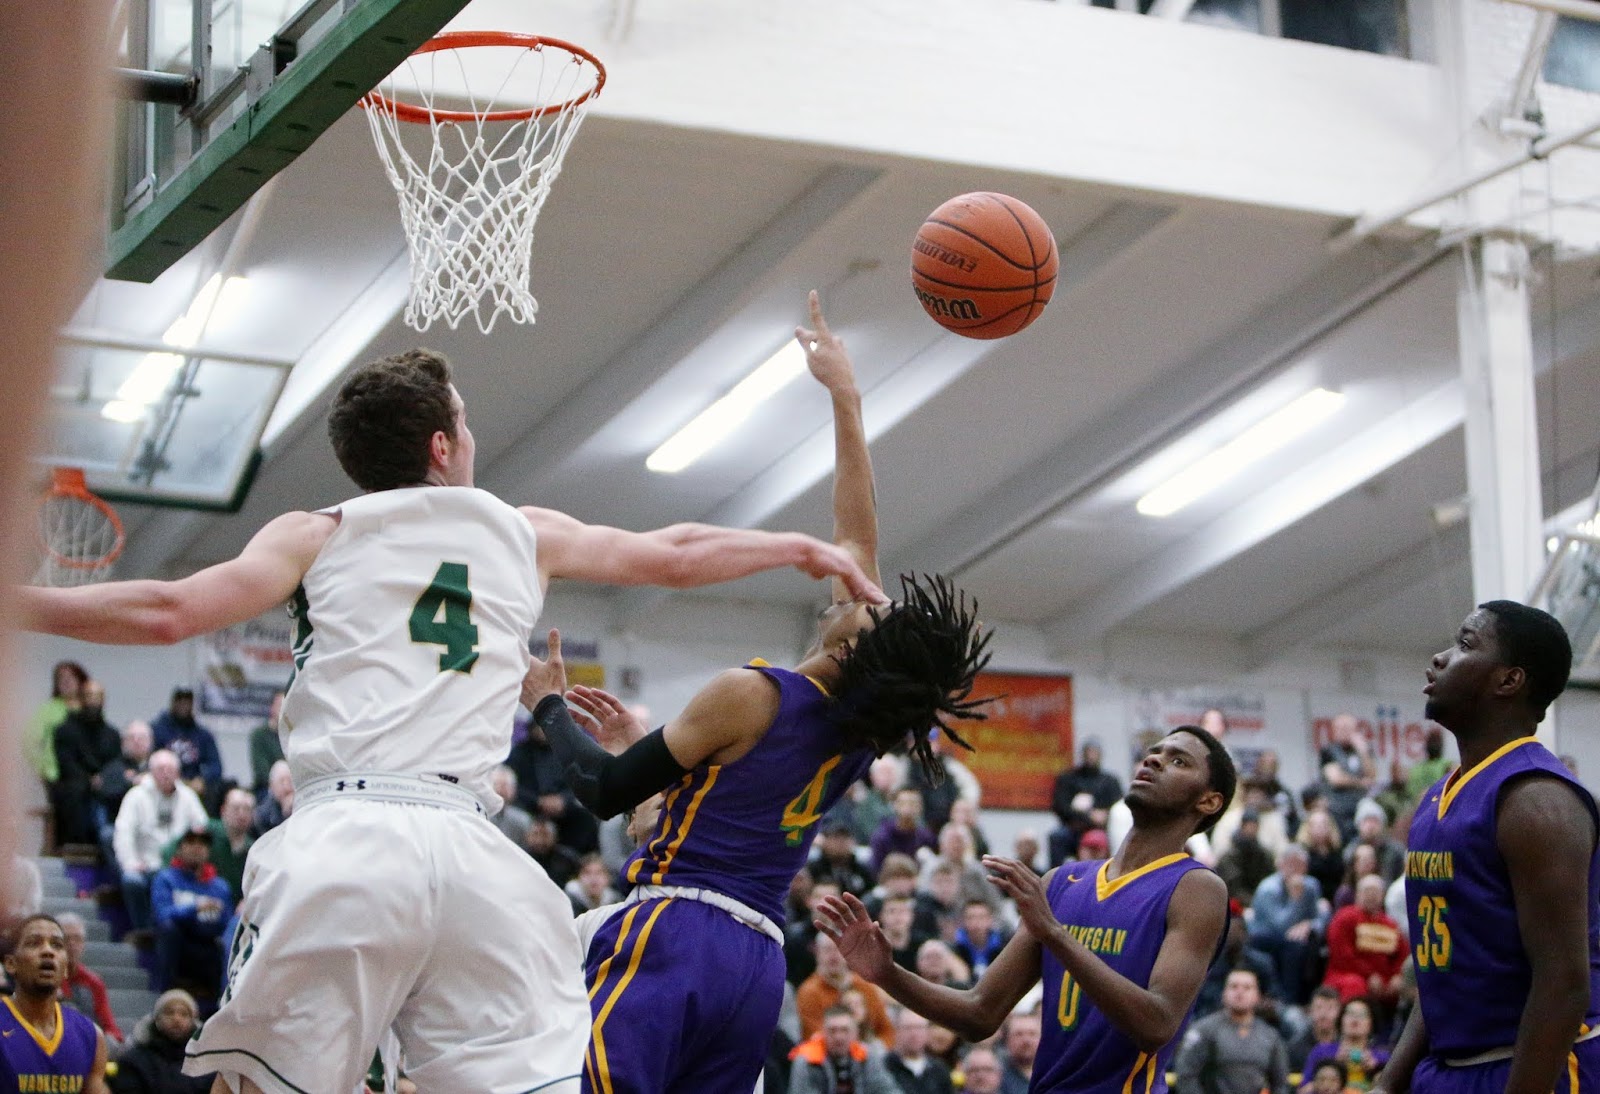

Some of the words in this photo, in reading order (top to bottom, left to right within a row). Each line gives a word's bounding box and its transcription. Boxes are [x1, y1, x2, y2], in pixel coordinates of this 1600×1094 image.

[913, 238, 978, 273] EVOLUTI
[912, 282, 983, 320] Wilso
[408, 560, 480, 675] 4
[1312, 704, 1443, 762] mije
[778, 753, 842, 847] 4
[1061, 924, 1128, 955] KEGAN
[1416, 895, 1452, 972] 35
[1058, 969, 1081, 1032] 0
